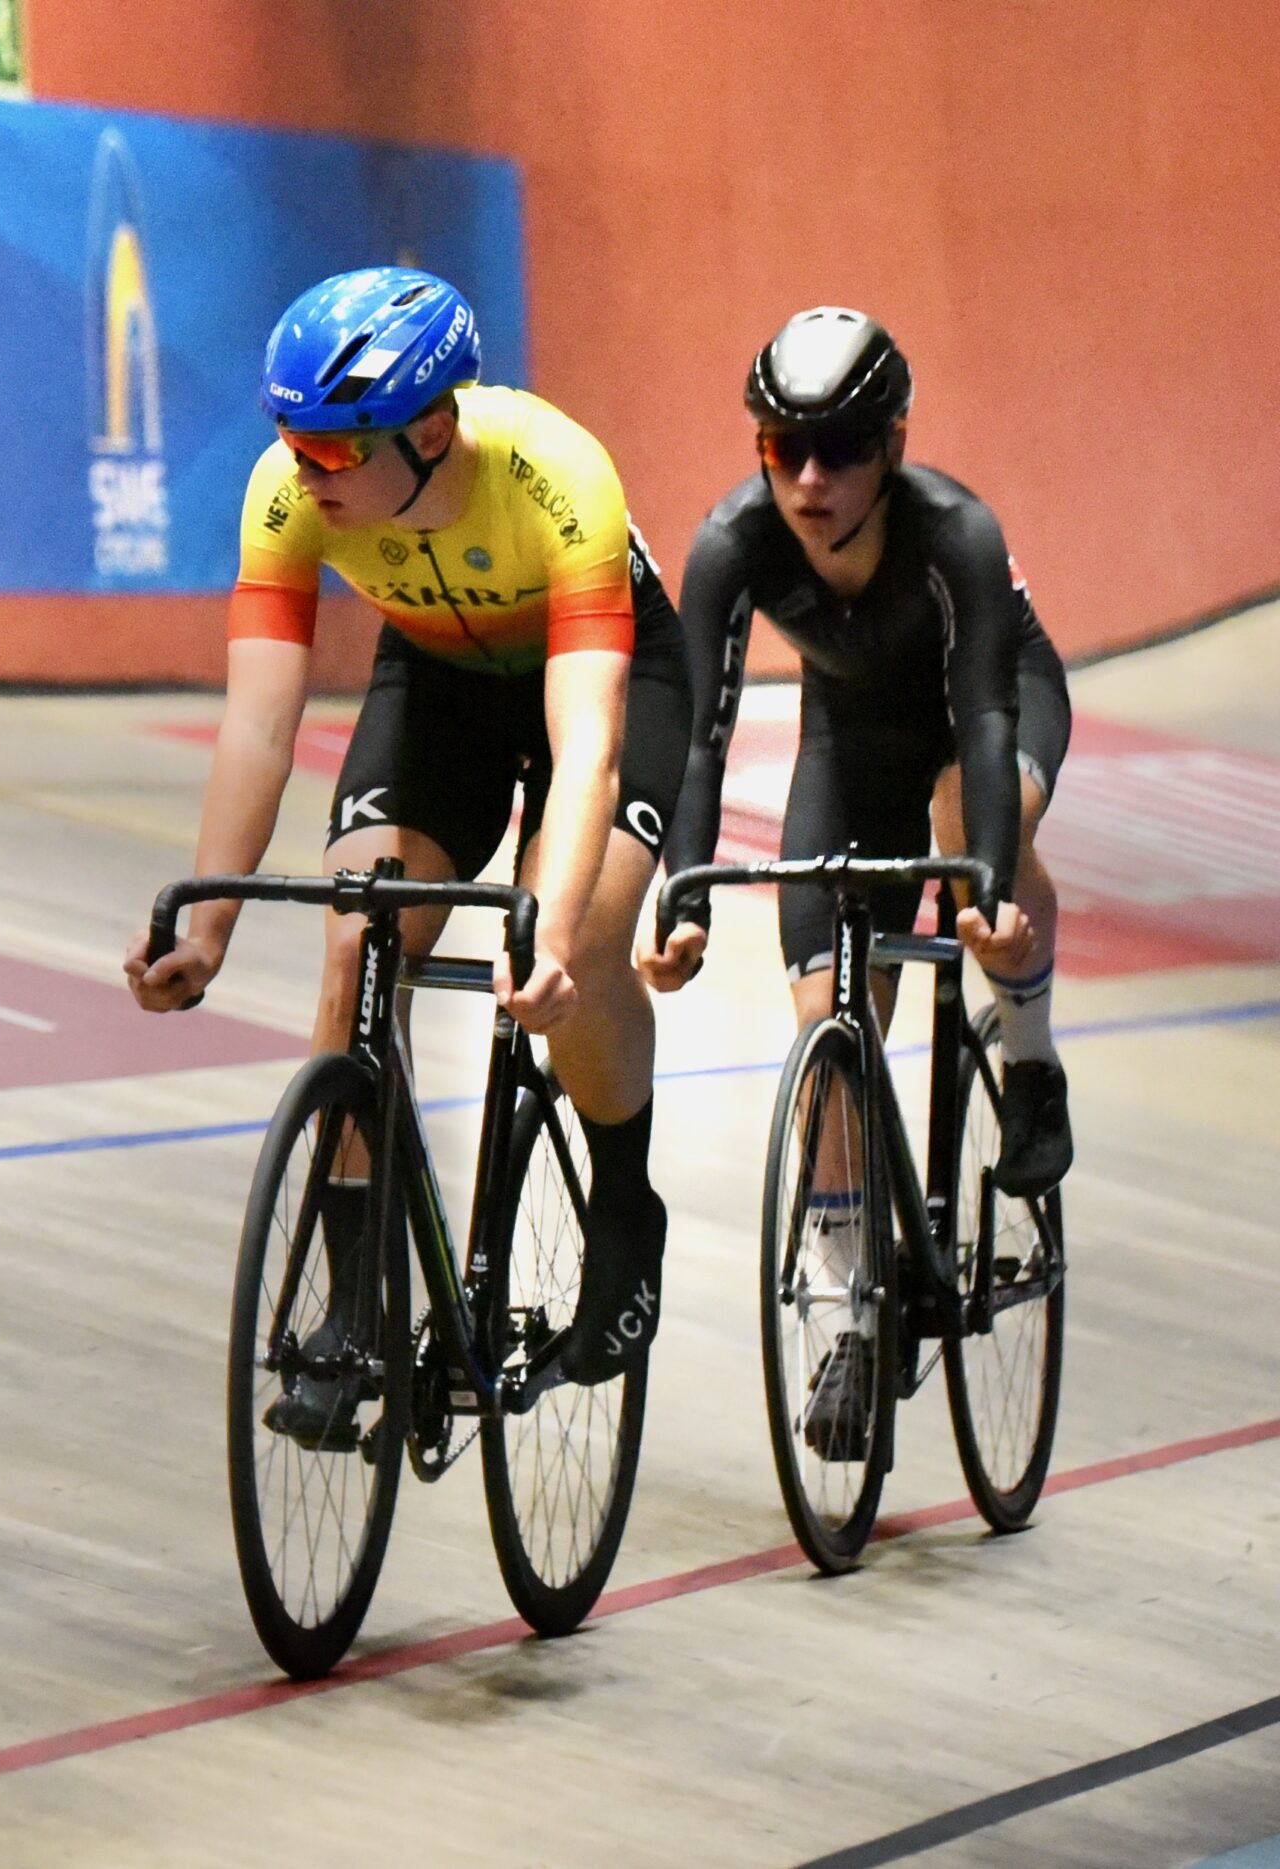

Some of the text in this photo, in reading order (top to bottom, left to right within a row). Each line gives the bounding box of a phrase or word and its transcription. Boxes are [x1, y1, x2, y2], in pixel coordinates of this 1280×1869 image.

[434, 304, 468, 362] GIRO
[269, 382, 304, 404] GIRO
[359, 942, 379, 1036] LOOK
[839, 921, 853, 1005] LOOK
[604, 1279, 657, 1356] JCK
